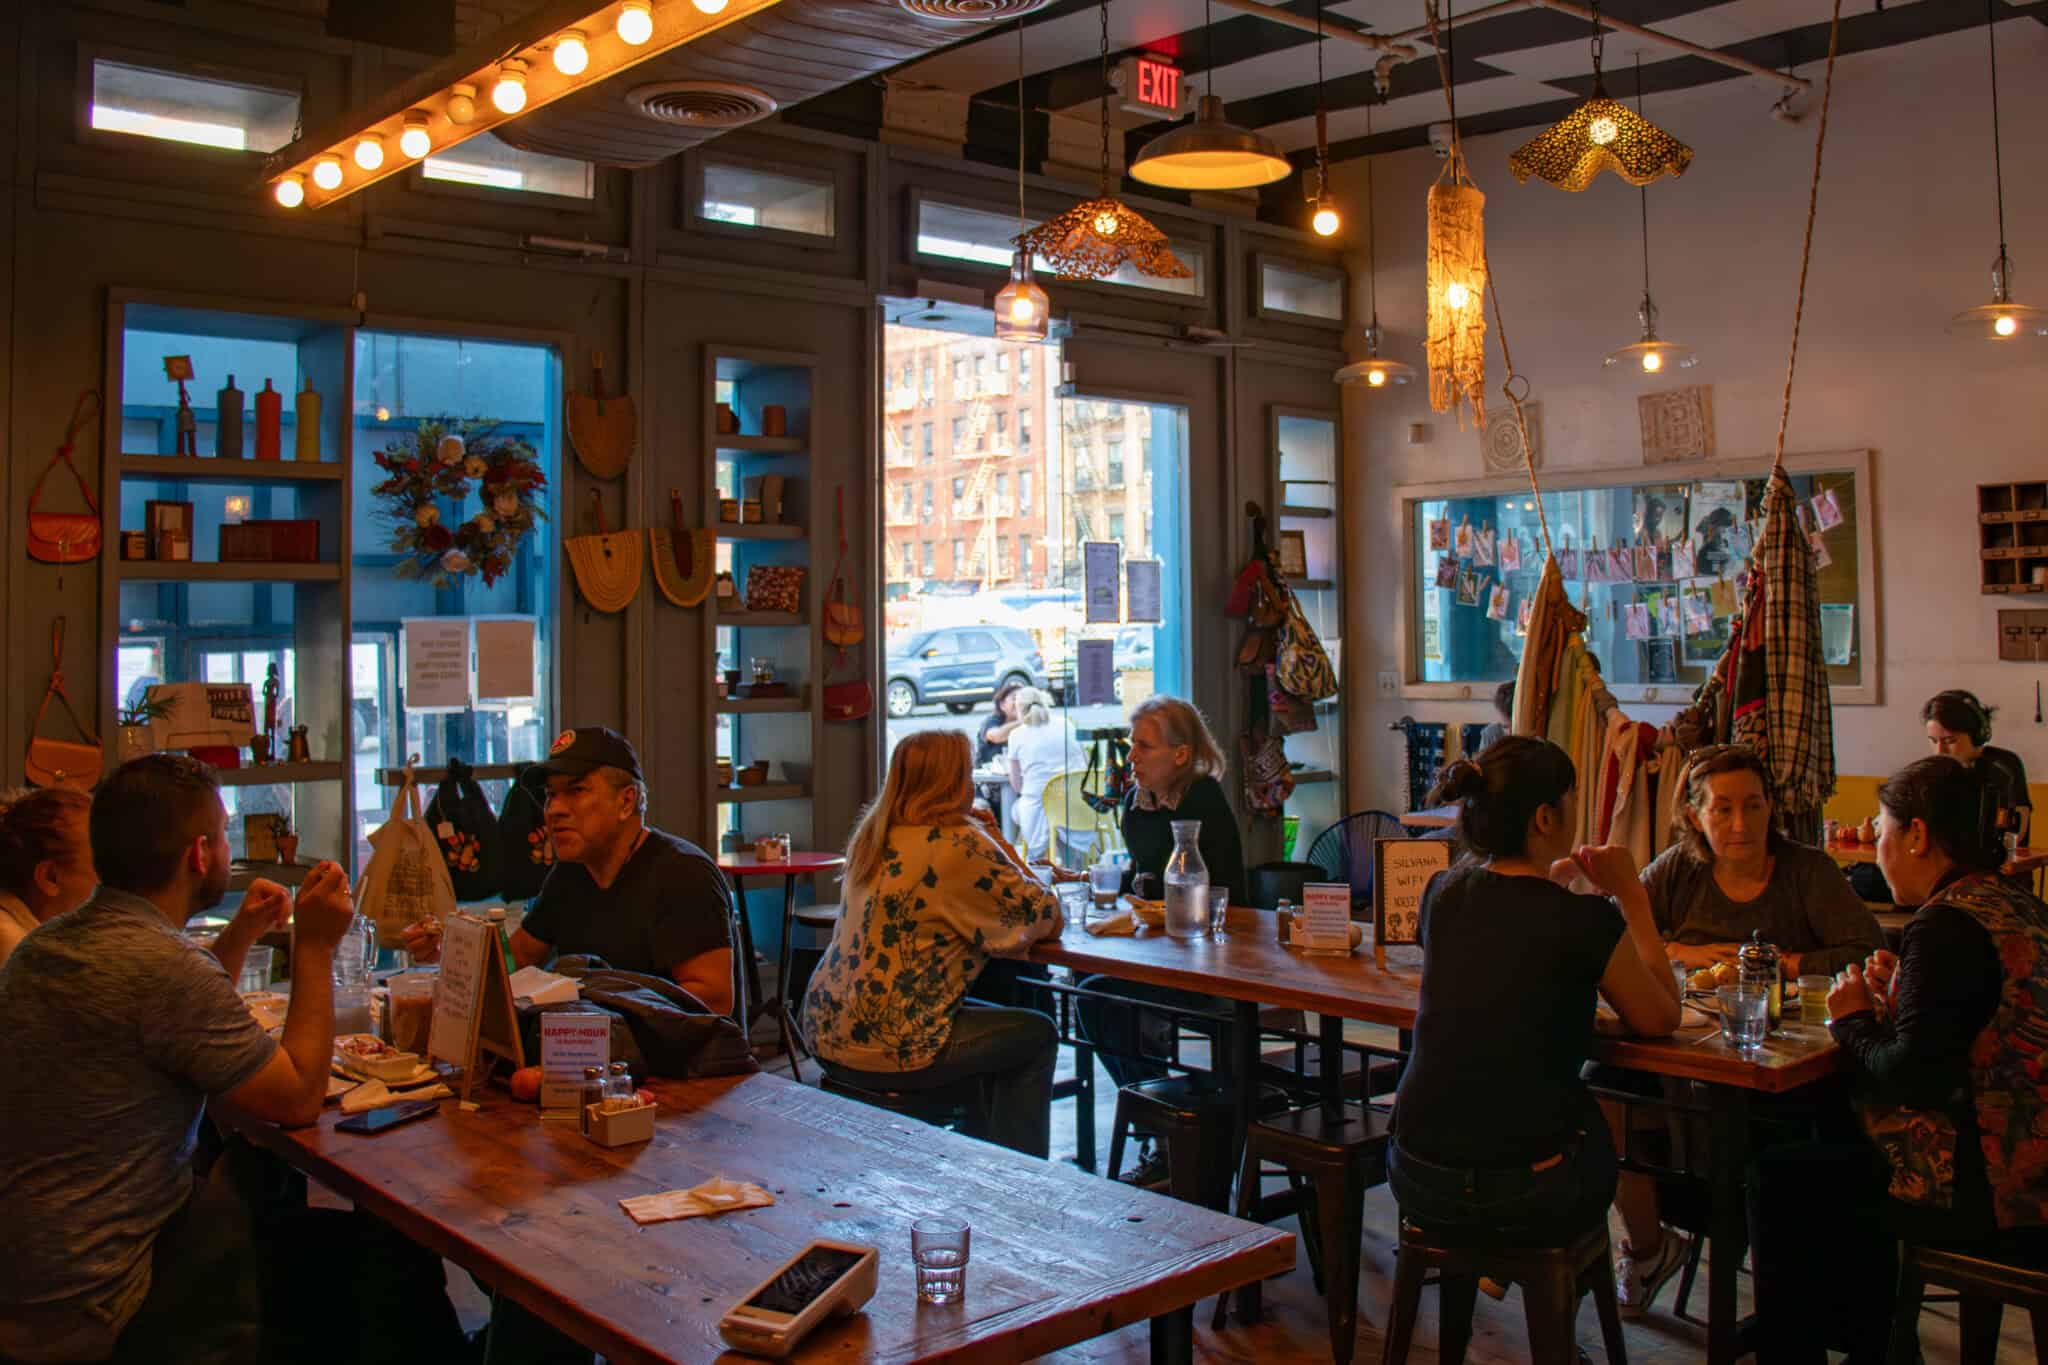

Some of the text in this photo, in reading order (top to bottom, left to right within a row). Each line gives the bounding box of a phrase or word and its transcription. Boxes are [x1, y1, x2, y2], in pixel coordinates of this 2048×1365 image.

[1138, 61, 1180, 109] EXIT
[1393, 856, 1440, 869] SILVANA
[544, 1028, 607, 1037] HAPPY HOUR
